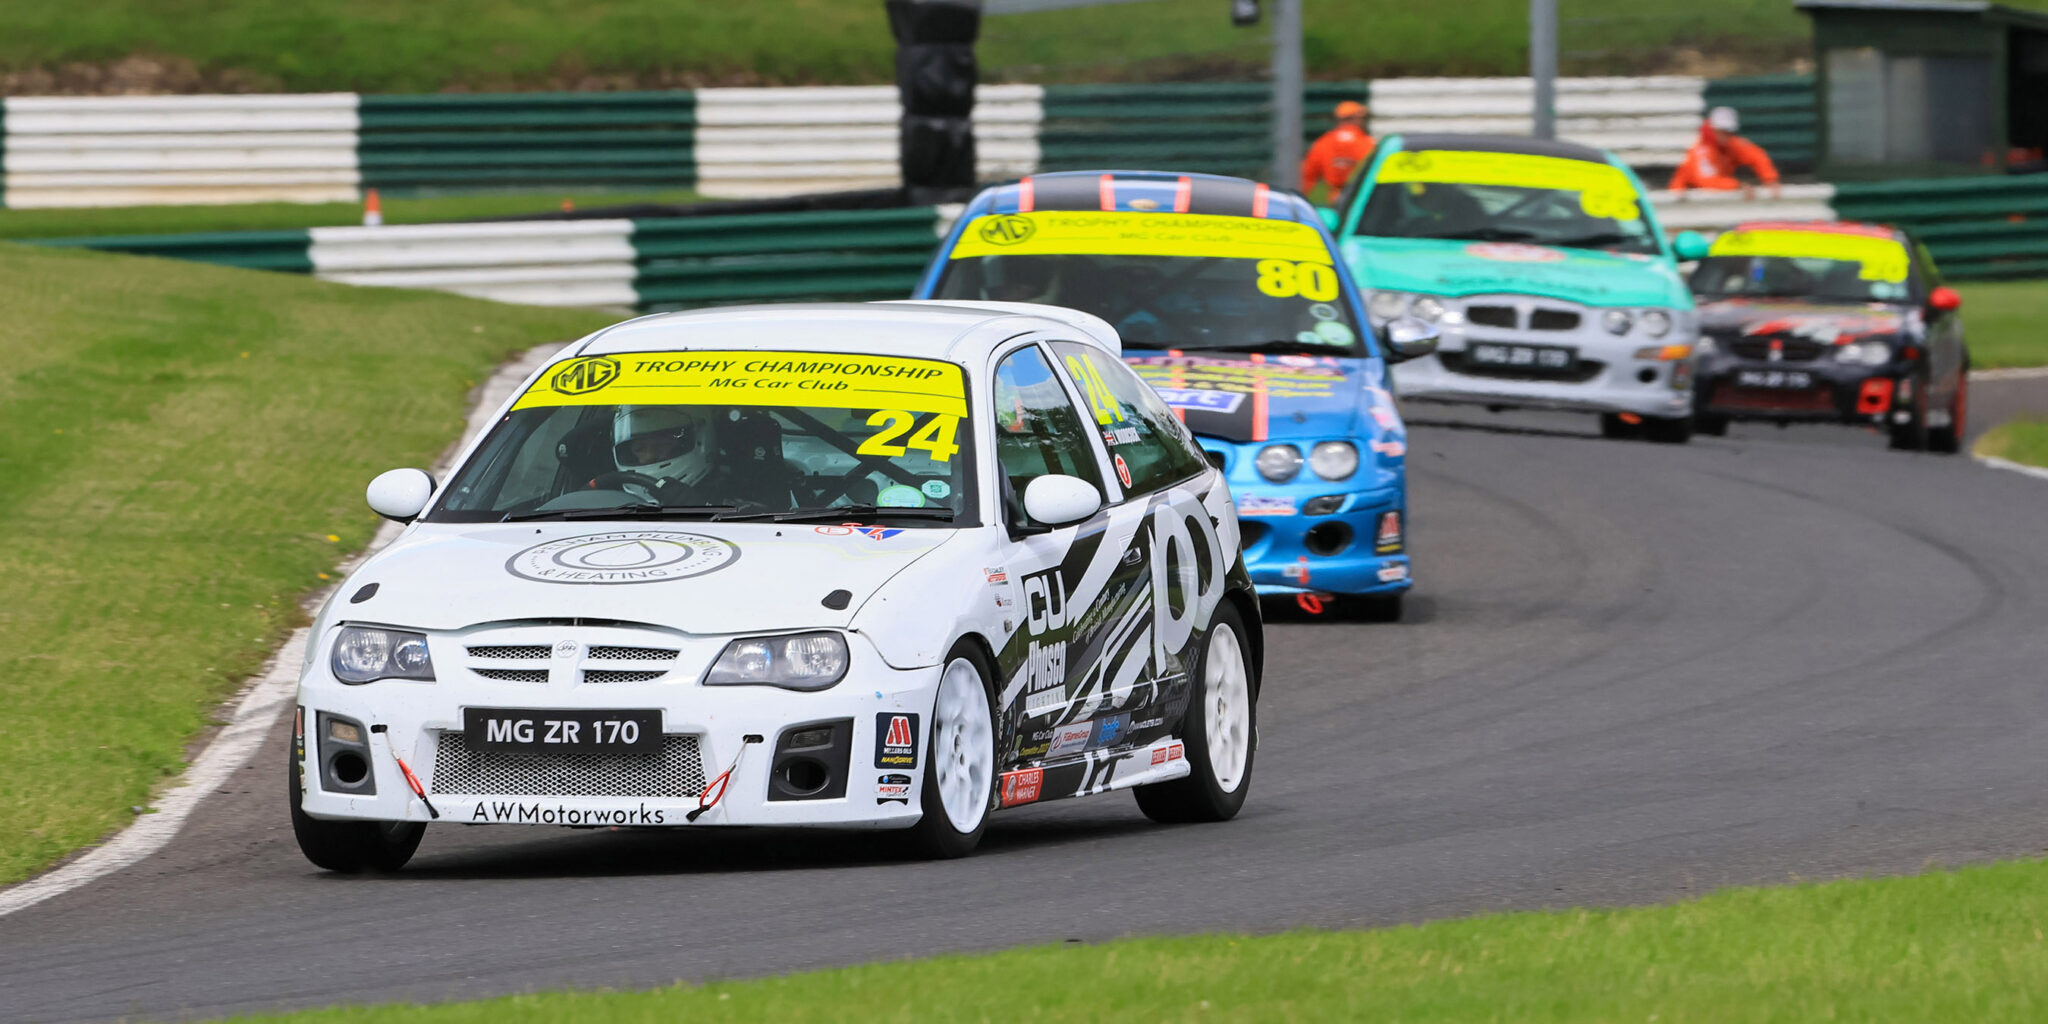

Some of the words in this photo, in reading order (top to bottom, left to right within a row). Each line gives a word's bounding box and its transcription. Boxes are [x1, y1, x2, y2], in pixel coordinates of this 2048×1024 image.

[980, 215, 1035, 245] MG
[1047, 217, 1133, 228] TROPHY
[1141, 217, 1301, 234] CHAMPIONSHIP
[1256, 259, 1339, 302] 80
[554, 358, 619, 394] MG
[634, 361, 740, 374] TROPHY
[744, 360, 944, 380] CHAMPIONSHIP
[708, 377, 748, 389] MG
[758, 378, 791, 391] Car
[797, 378, 849, 391] Club
[1066, 354, 1123, 424] 24
[856, 410, 959, 462] 24
[538, 568, 556, 578] &
[556, 568, 668, 580] HEATING
[1024, 570, 1066, 636] CU
[1027, 640, 1067, 693] Phosco
[487, 720, 533, 744] MG
[544, 720, 582, 744] ZR
[592, 720, 640, 744] 170
[1018, 772, 1039, 786] CHARLES
[1016, 786, 1036, 800] WARNER
[472, 802, 665, 825] AWMotorworks
